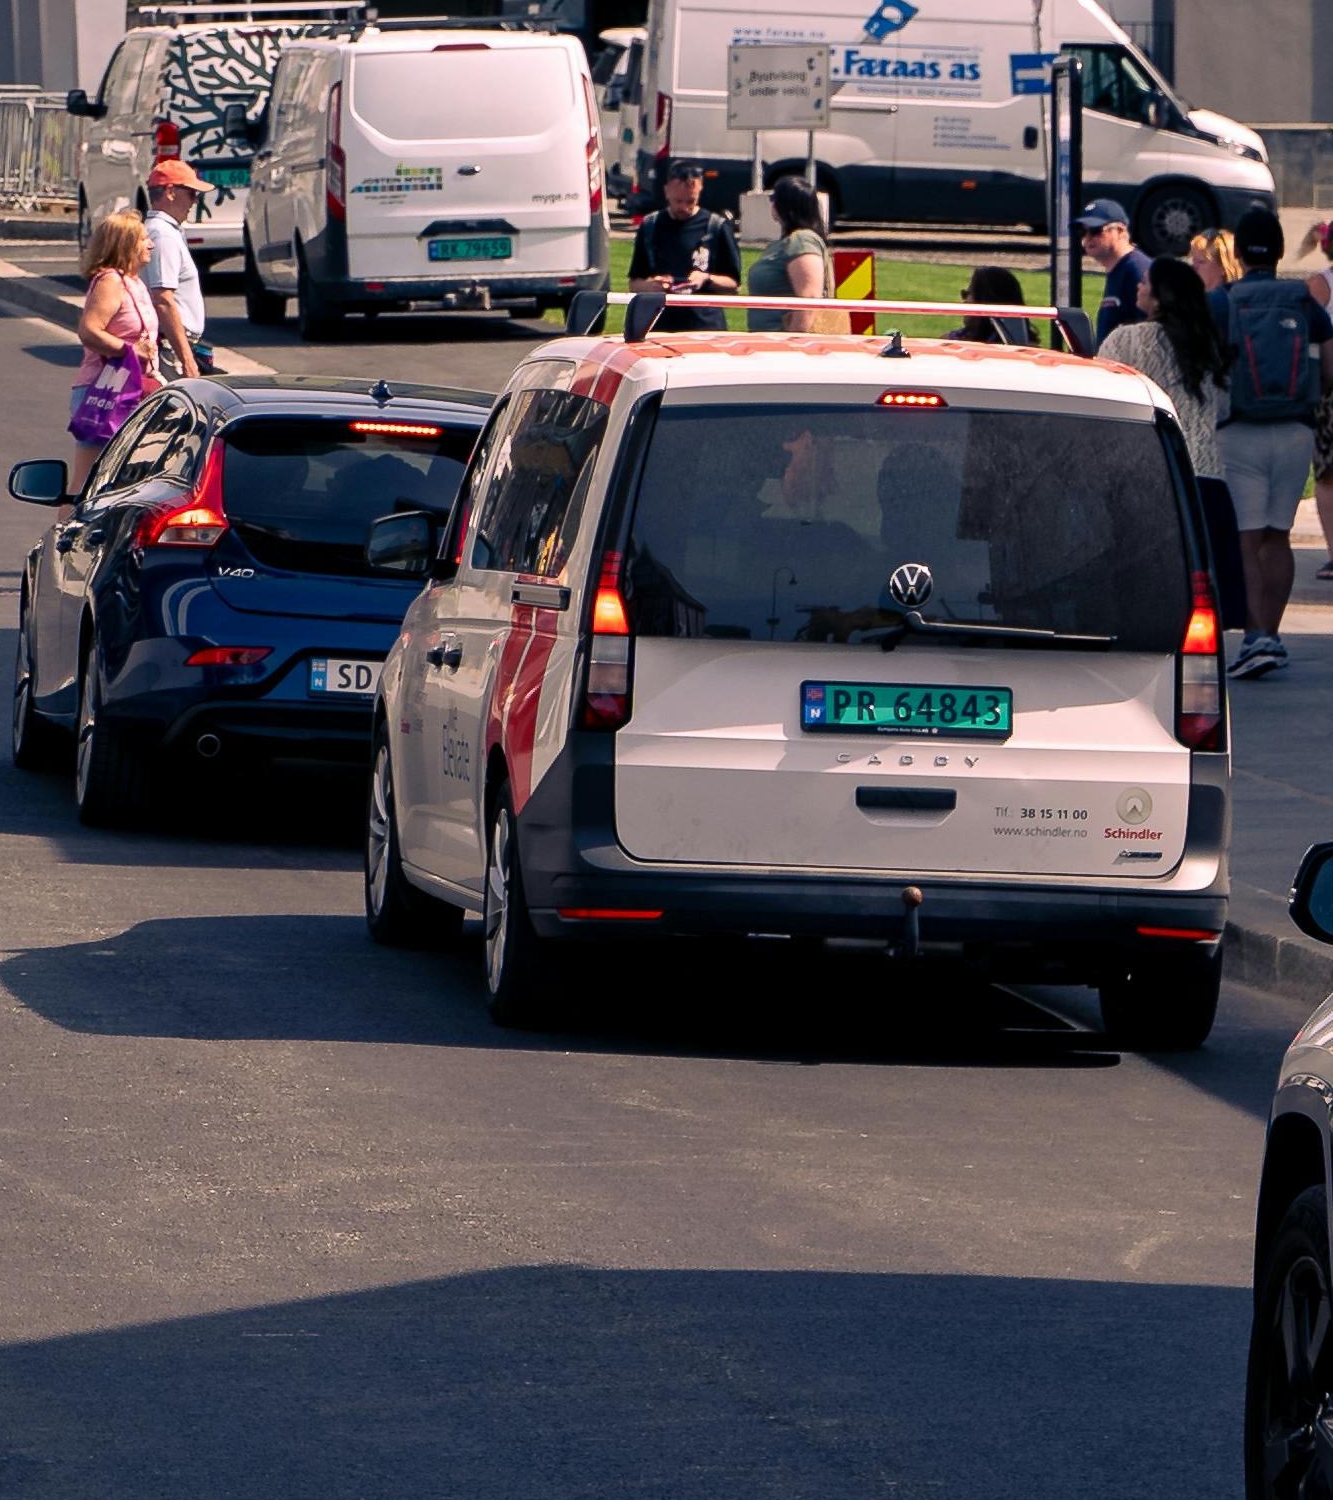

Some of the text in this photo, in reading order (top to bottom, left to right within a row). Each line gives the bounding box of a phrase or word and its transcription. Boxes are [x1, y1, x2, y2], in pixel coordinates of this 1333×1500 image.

[949, 62, 981, 81] as
[531, 192, 580, 203] myge.no
[218, 567, 254, 578] V40
[337, 663, 372, 690] SD
[832, 689, 876, 721] PR
[893, 691, 1001, 726] 64843
[1020, 808, 1036, 819] 38
[1040, 808, 1053, 819] 15
[1058, 809, 1068, 820] 11
[1073, 809, 1088, 820] 00
[993, 826, 1088, 839] www.schindler.no
[1104, 827, 1163, 841] Schindler
